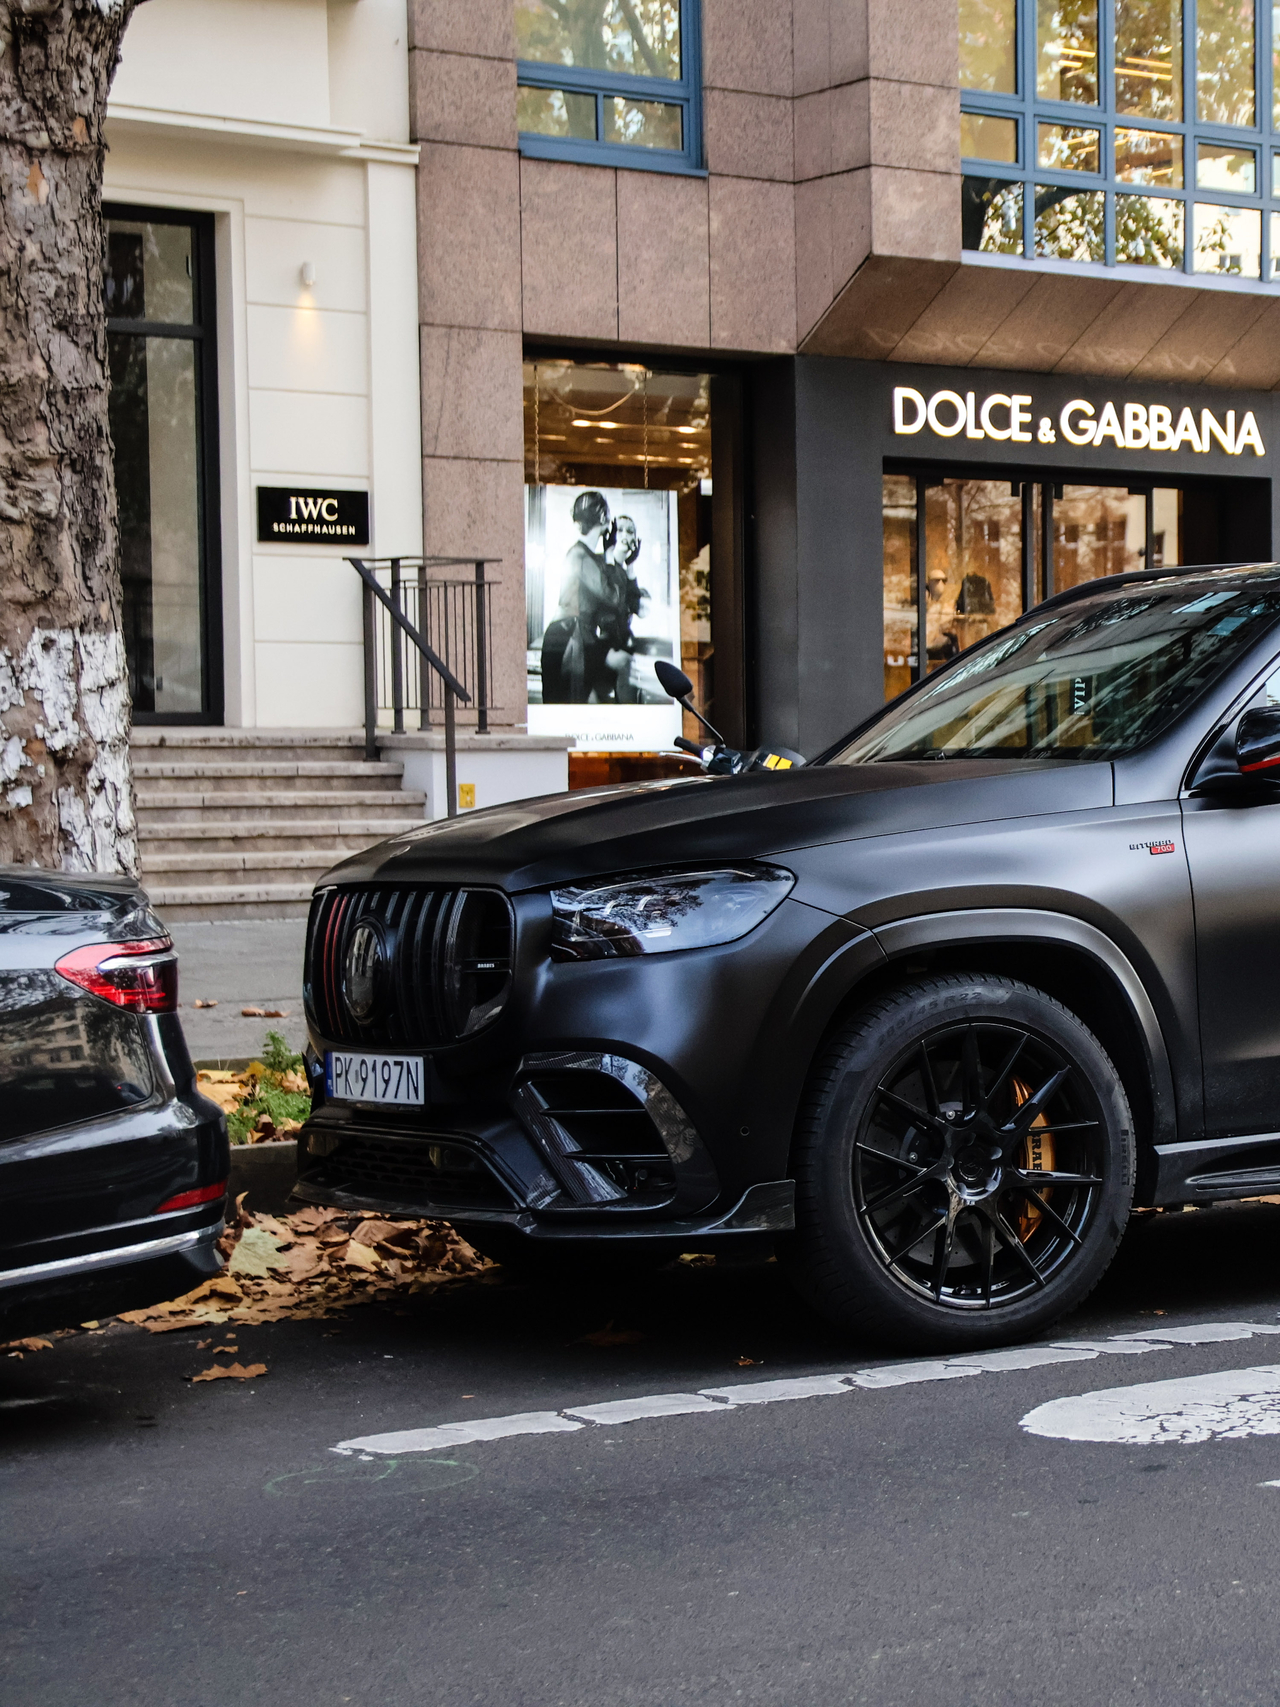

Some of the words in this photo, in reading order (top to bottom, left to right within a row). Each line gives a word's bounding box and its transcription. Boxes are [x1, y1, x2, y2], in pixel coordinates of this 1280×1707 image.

[893, 386, 1033, 443] DOLCE
[1037, 416, 1057, 444] &
[1060, 398, 1266, 457] GABBANA
[289, 496, 338, 521] IWC
[272, 522, 356, 536] SCHAFFHAUSEN
[1155, 844, 1172, 853] 700
[335, 1056, 354, 1096] PK
[359, 1058, 420, 1101] 9197N
